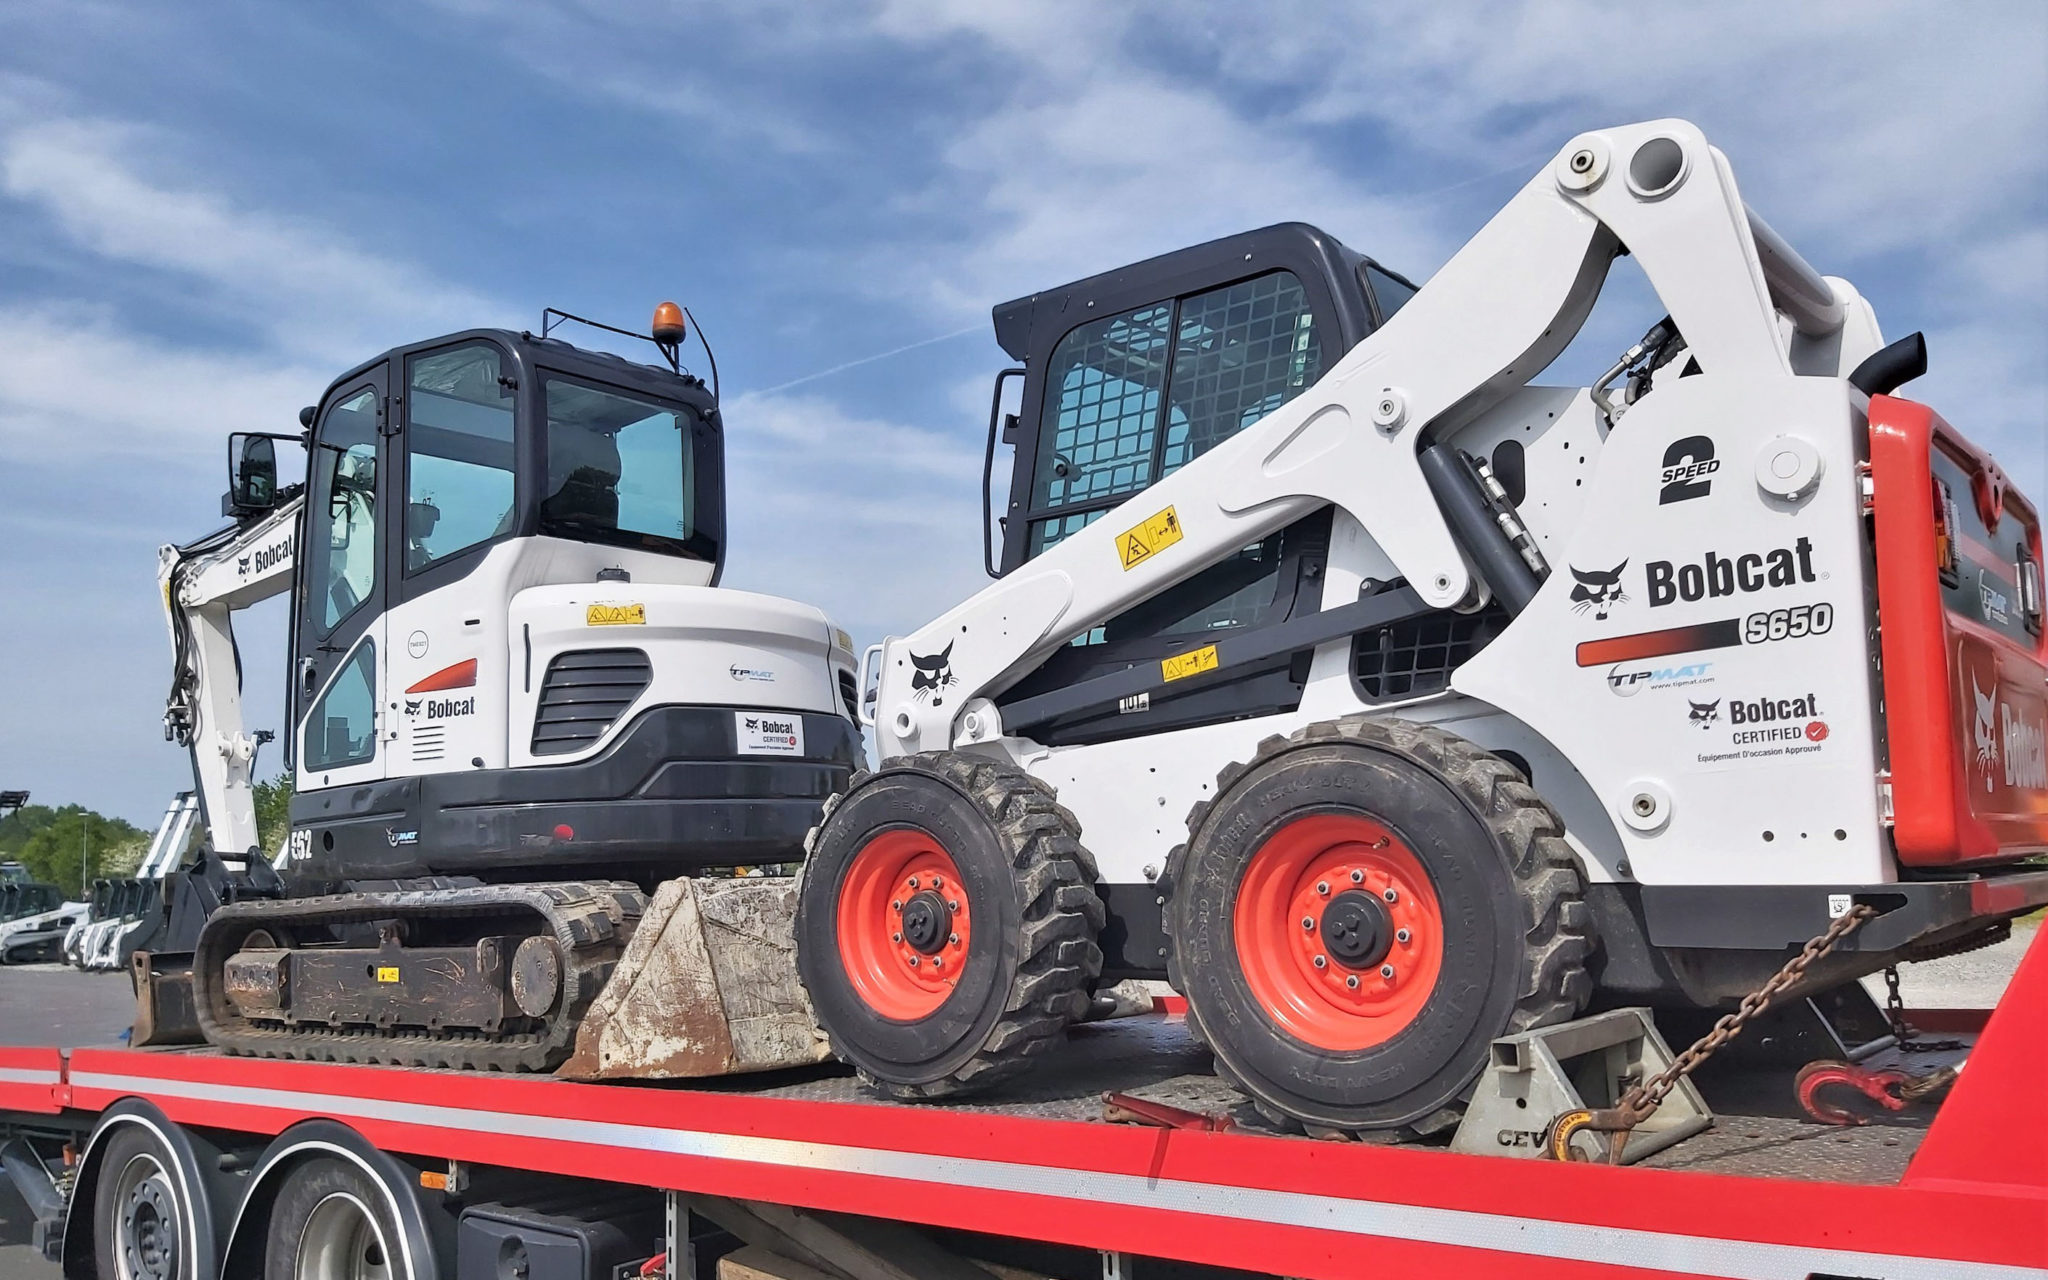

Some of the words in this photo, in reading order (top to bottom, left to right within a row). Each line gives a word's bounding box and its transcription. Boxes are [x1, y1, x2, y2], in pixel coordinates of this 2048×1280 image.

[1659, 435, 1715, 505] 2
[1661, 459, 1720, 484] SPEED
[255, 534, 293, 574] Bobcat
[1646, 537, 1816, 608] Bobcat
[1746, 602, 1833, 644] S650
[1650, 678, 1715, 690] www.tipmat.com
[428, 697, 474, 719] Bobcat
[1730, 693, 1818, 725] Bobcat
[762, 720, 794, 734] Bobcat
[1733, 727, 1802, 745] CERTIFIED
[1743, 747, 1783, 758] D'occasion
[1785, 744, 1822, 756] Approuvé
[291, 829, 312, 860] E62
